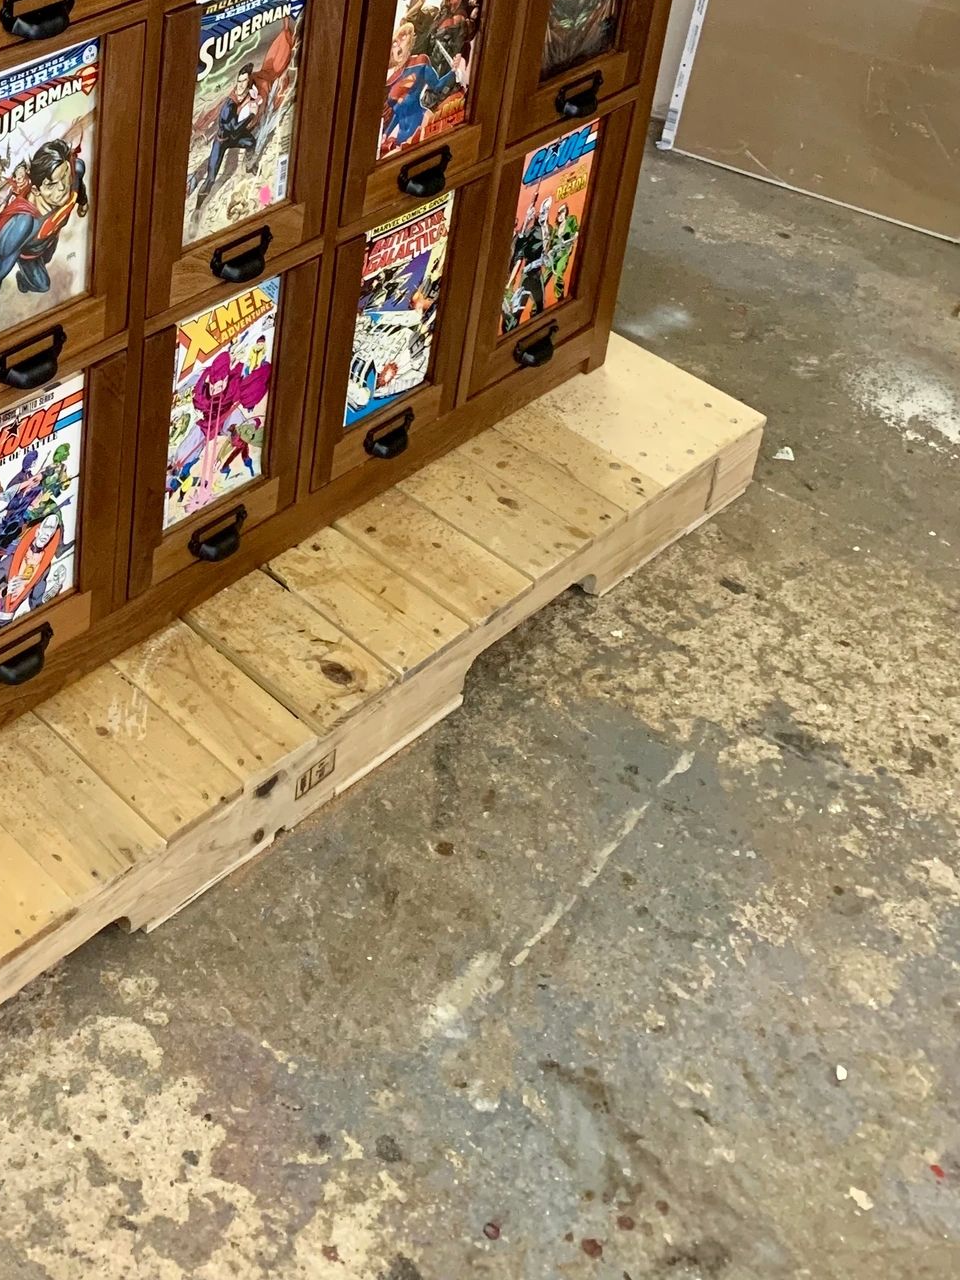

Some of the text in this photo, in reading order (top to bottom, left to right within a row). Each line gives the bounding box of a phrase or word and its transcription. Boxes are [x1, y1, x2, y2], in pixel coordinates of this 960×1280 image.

[10, 56, 65, 82] UNIVERSE
[196, 4, 292, 82] SUPERMAN
[178, 286, 273, 375] X-MEN
[38, 392, 55, 405] SERIES
